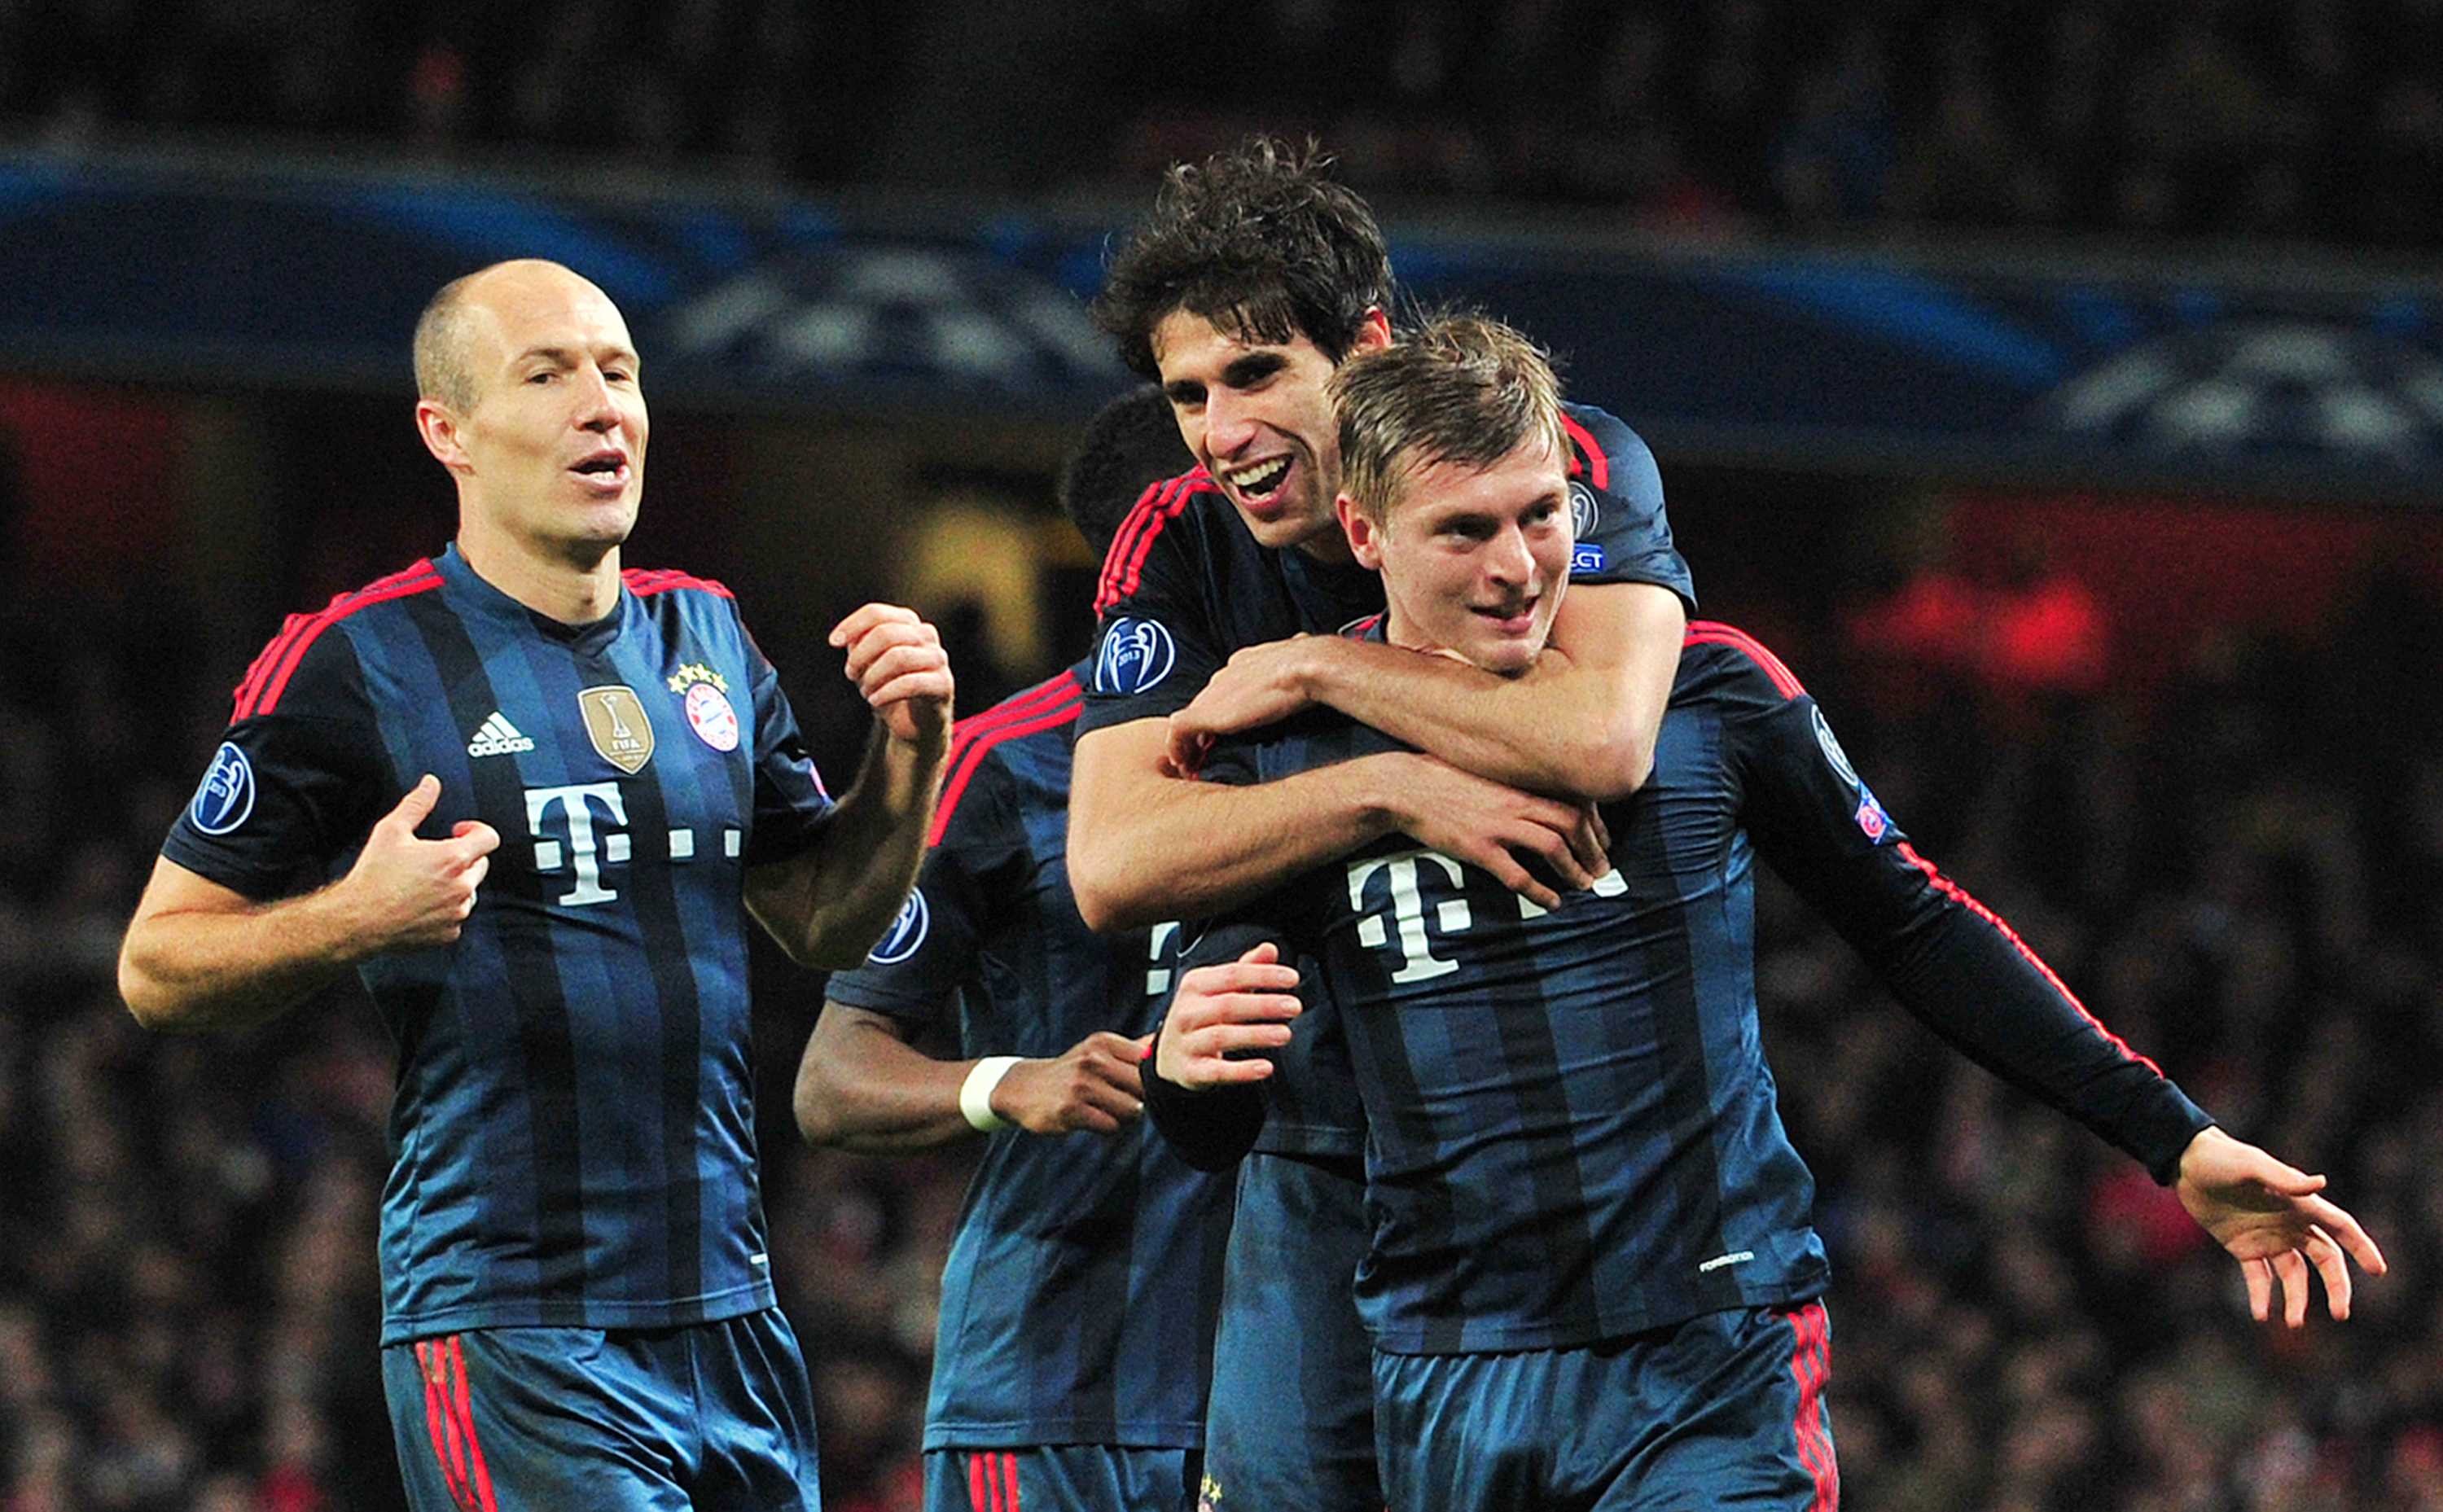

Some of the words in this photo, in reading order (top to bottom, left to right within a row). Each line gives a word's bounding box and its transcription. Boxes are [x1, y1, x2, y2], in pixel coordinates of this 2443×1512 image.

[467, 736, 535, 758] adidas
[612, 738, 641, 750] FIFA
[524, 781, 630, 907] T
